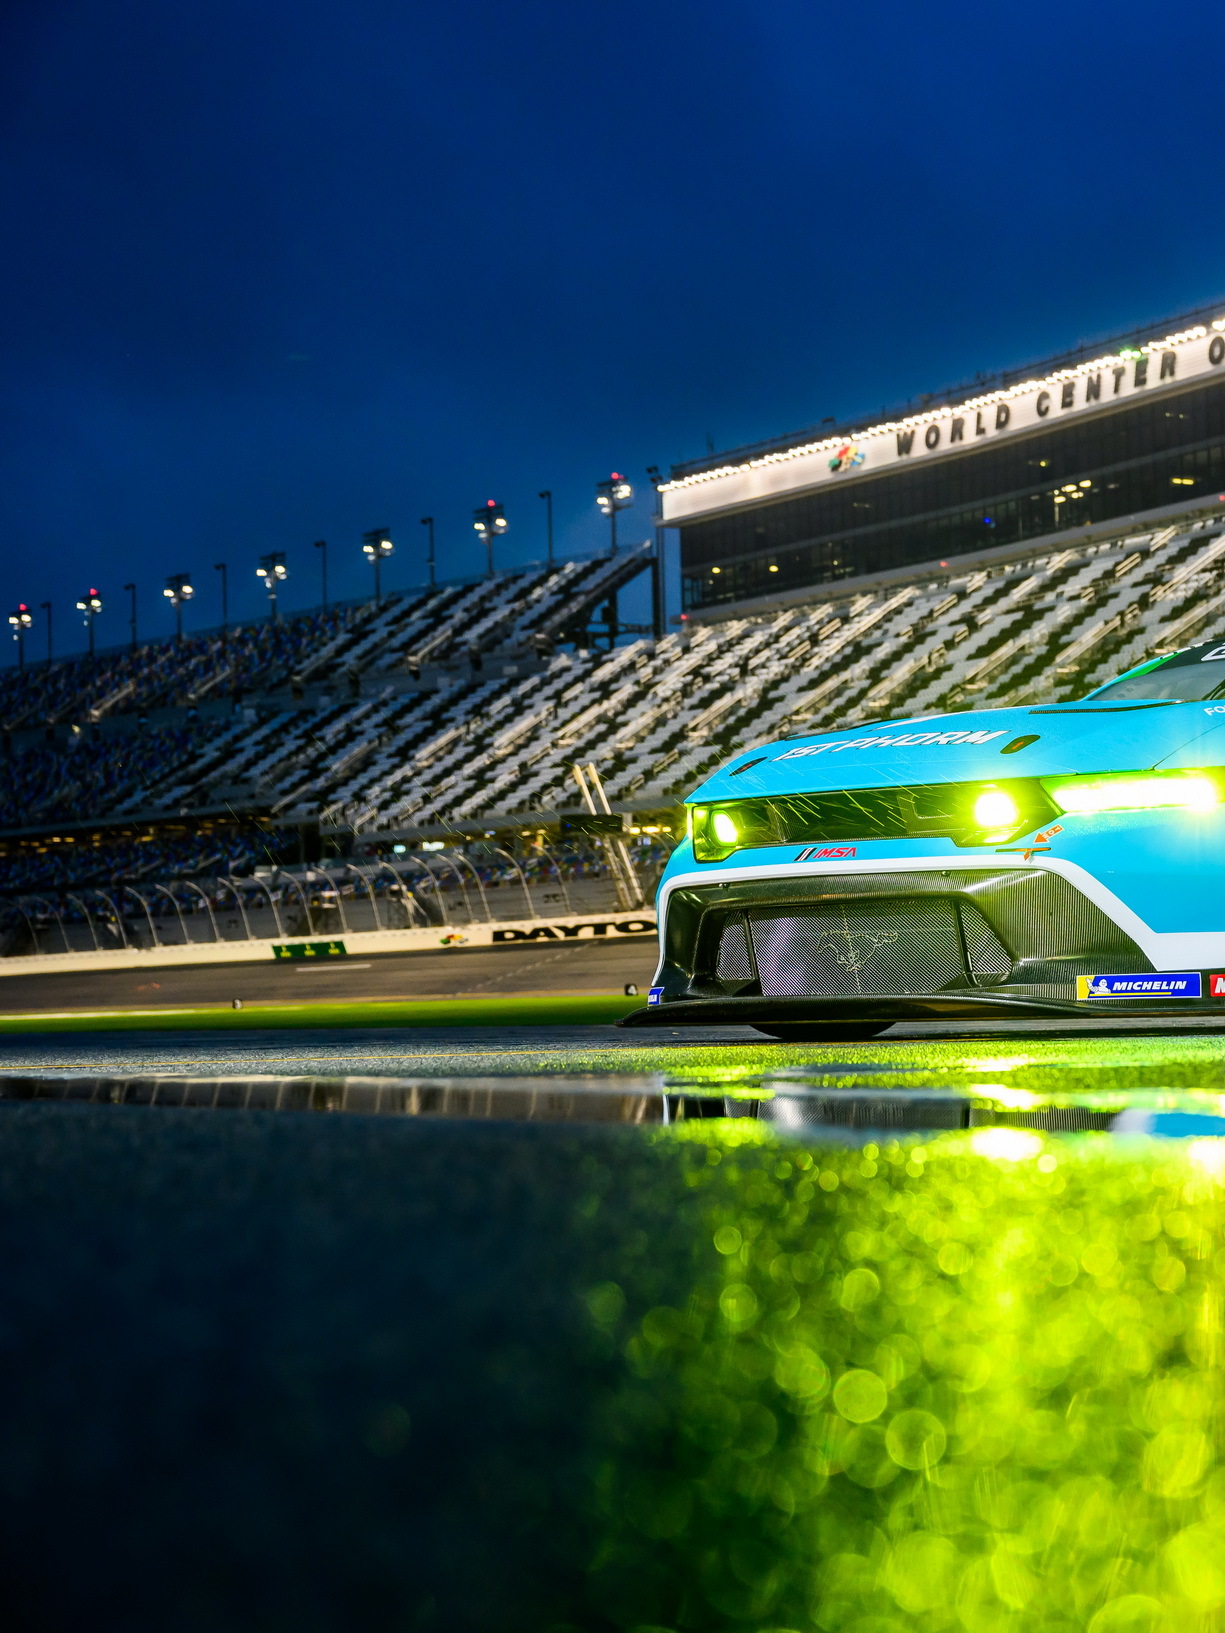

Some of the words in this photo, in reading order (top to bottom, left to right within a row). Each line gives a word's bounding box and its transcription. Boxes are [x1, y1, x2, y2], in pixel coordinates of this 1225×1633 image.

[897, 404, 1010, 456] WORLD
[1036, 351, 1177, 417] CENTER
[812, 847, 857, 859] IMSA
[1112, 980, 1187, 991] MICHELIN
